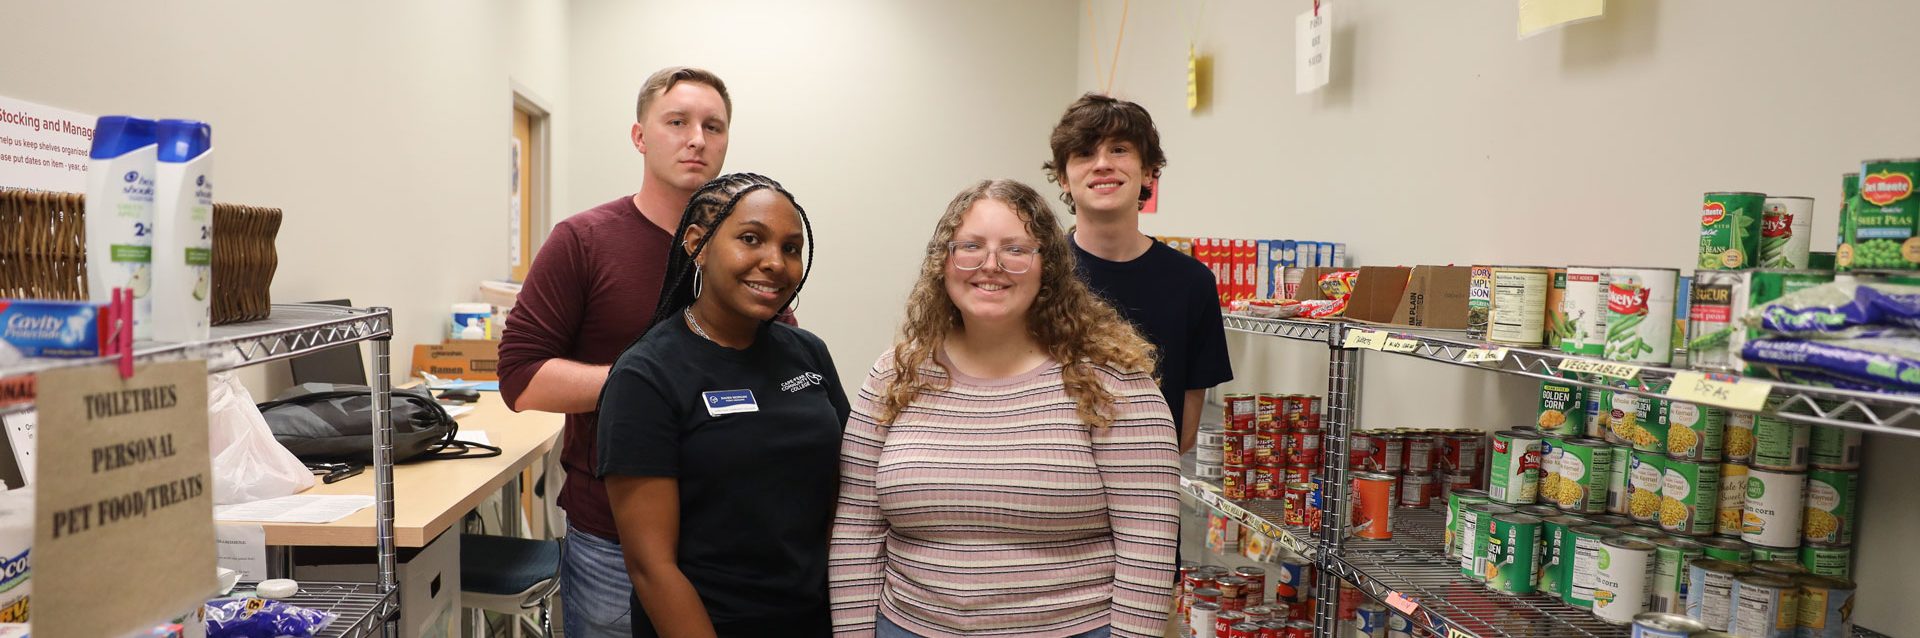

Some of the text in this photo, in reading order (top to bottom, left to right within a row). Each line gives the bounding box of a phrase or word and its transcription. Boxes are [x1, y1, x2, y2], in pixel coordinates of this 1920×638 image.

[43, 119, 60, 132] and
[14, 139, 22, 147] us
[23, 139, 39, 150] keep
[40, 142, 61, 153] shelves
[62, 146, 88, 157] organized
[13, 155, 24, 163] put
[25, 156, 41, 166] dates
[51, 159, 64, 169] item
[1885, 215, 1913, 226] PEAS
[1409, 292, 1417, 315] PLAIN
[8, 312, 63, 334] Cavity
[1563, 359, 1633, 377] VEGETABLES
[791, 381, 810, 392] COLLEGE
[84, 384, 178, 421] TOILETRIES
[1542, 391, 1570, 402] GOLDEN
[1544, 400, 1565, 410] CORN
[91, 434, 176, 474] PERSONAL
[52, 474, 204, 540] PET FOOD/TREATS
[1755, 508, 1775, 516] corn
[1602, 580, 1618, 588] corn
